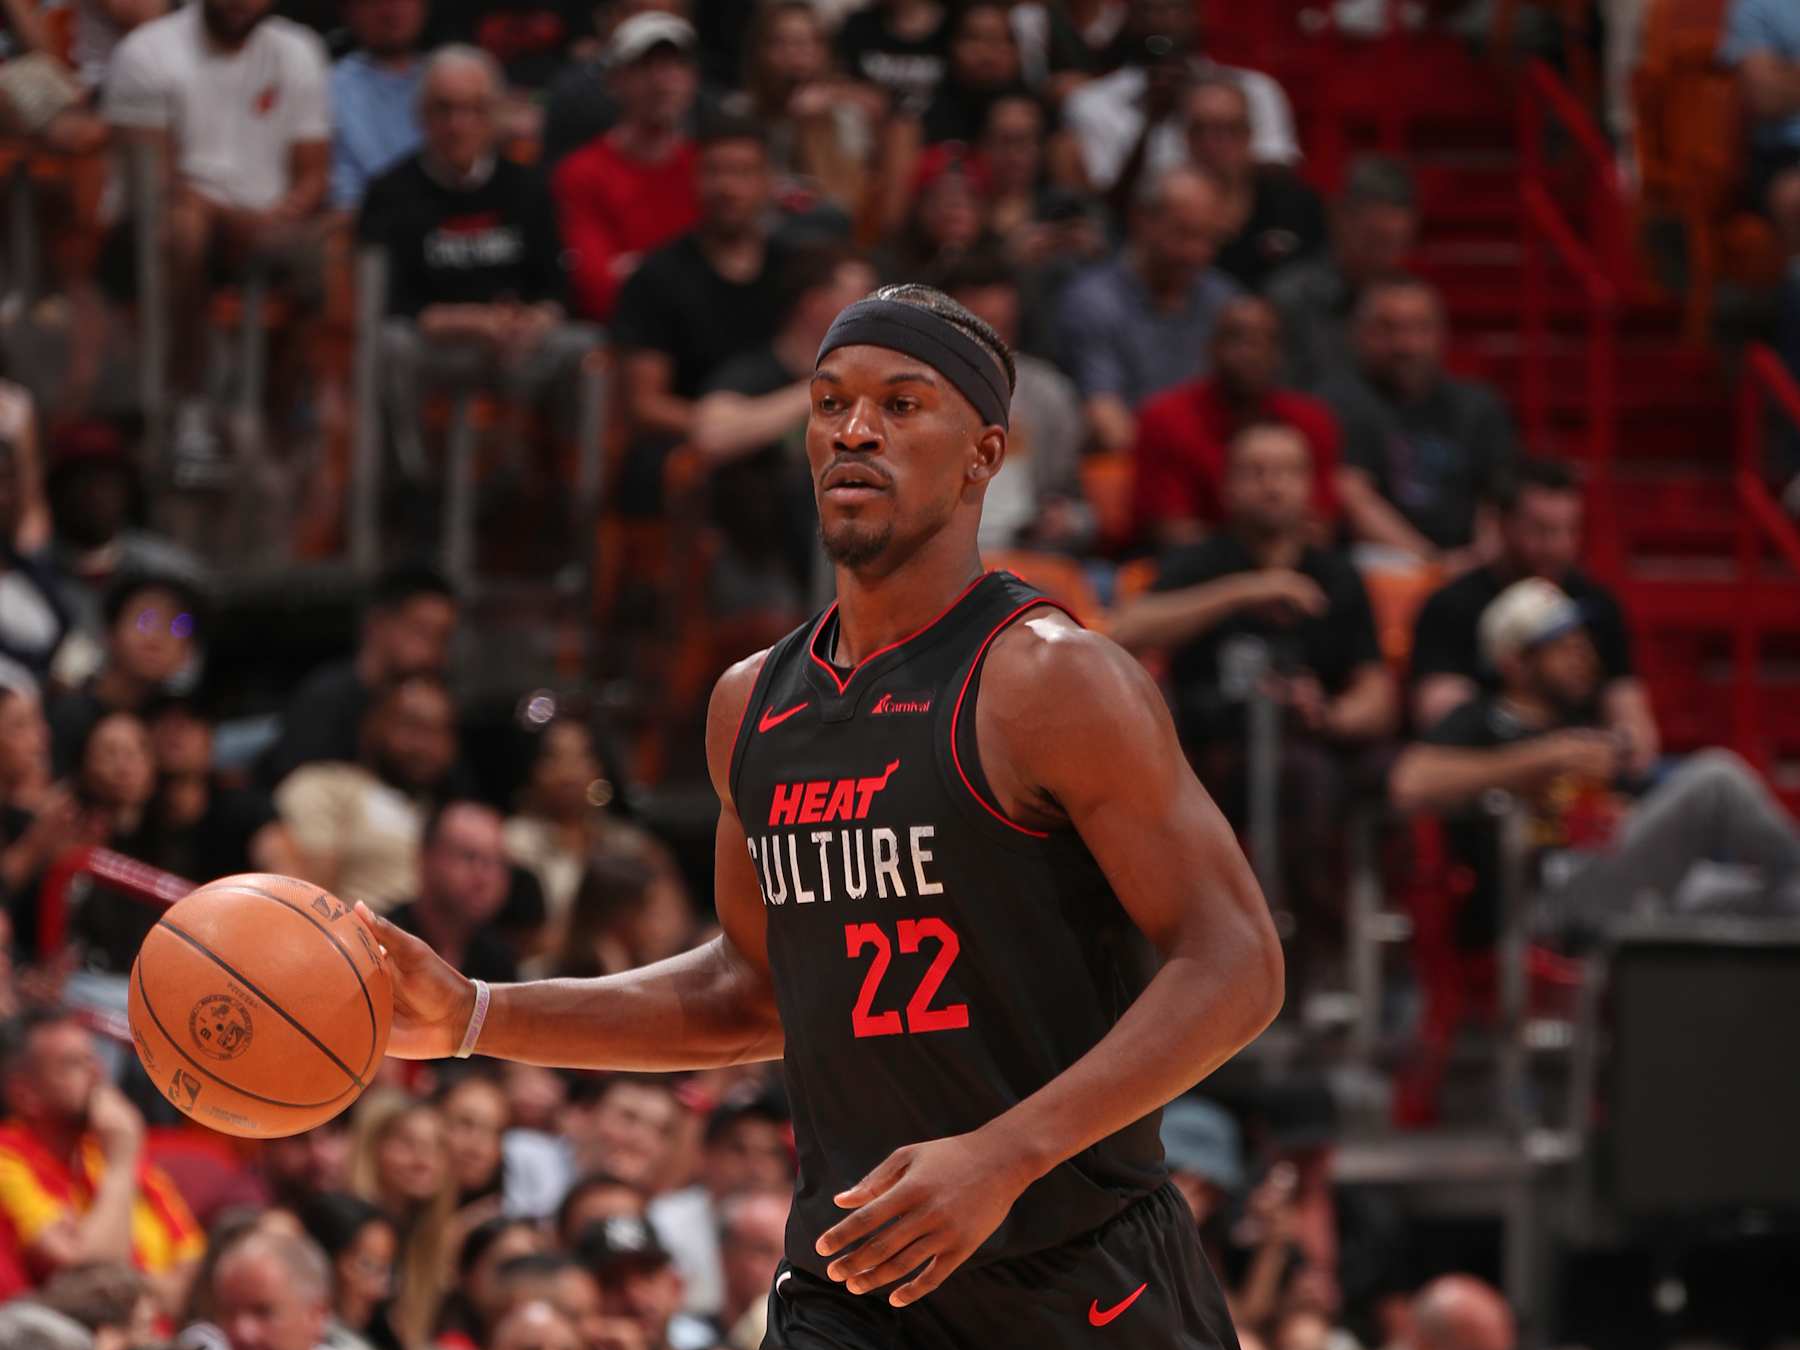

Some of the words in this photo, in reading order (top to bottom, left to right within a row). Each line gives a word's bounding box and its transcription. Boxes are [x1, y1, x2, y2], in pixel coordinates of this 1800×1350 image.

[883, 699, 932, 714] Carnival
[768, 759, 900, 827] HEAT
[844, 917, 970, 1039] 22
